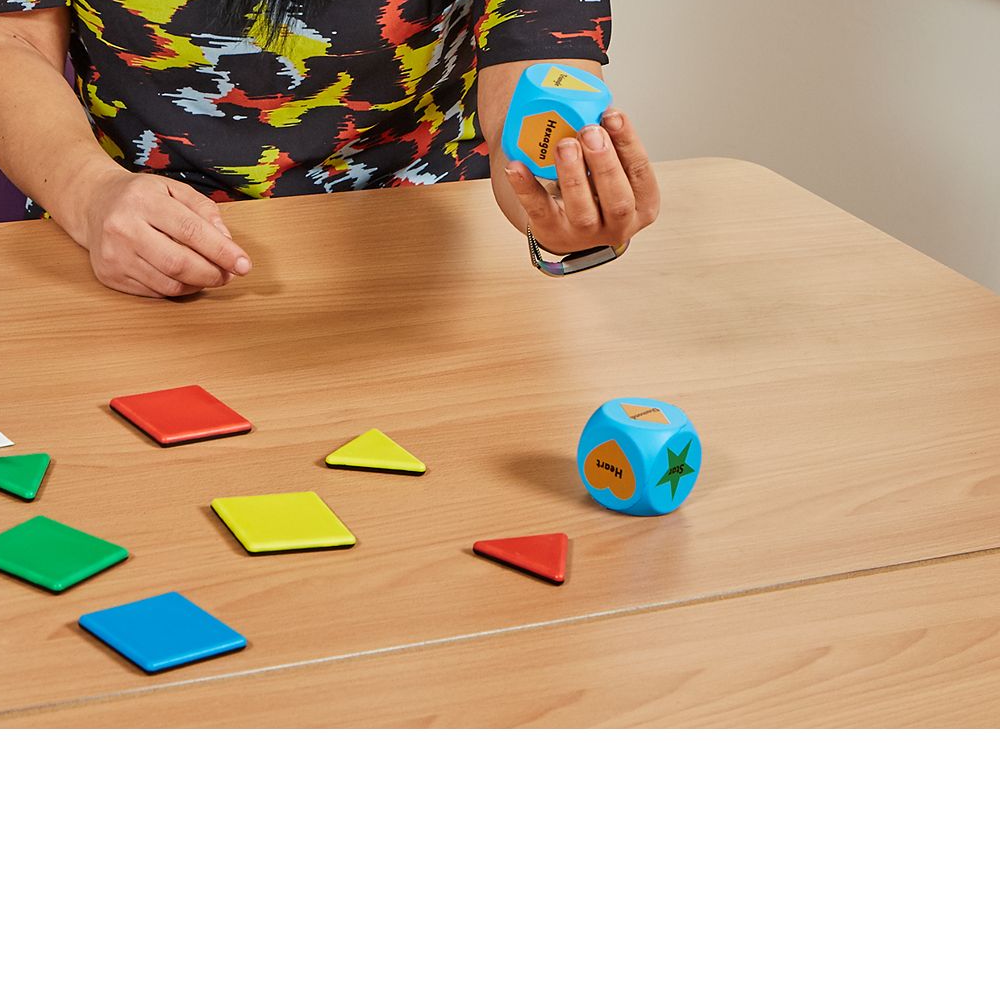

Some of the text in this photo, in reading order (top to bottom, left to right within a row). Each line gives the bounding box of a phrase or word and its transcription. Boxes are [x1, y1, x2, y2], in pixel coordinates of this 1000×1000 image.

[539, 119, 557, 160] Hexagon
[596, 459, 623, 479] Heart
[668, 464, 685, 475] Star
